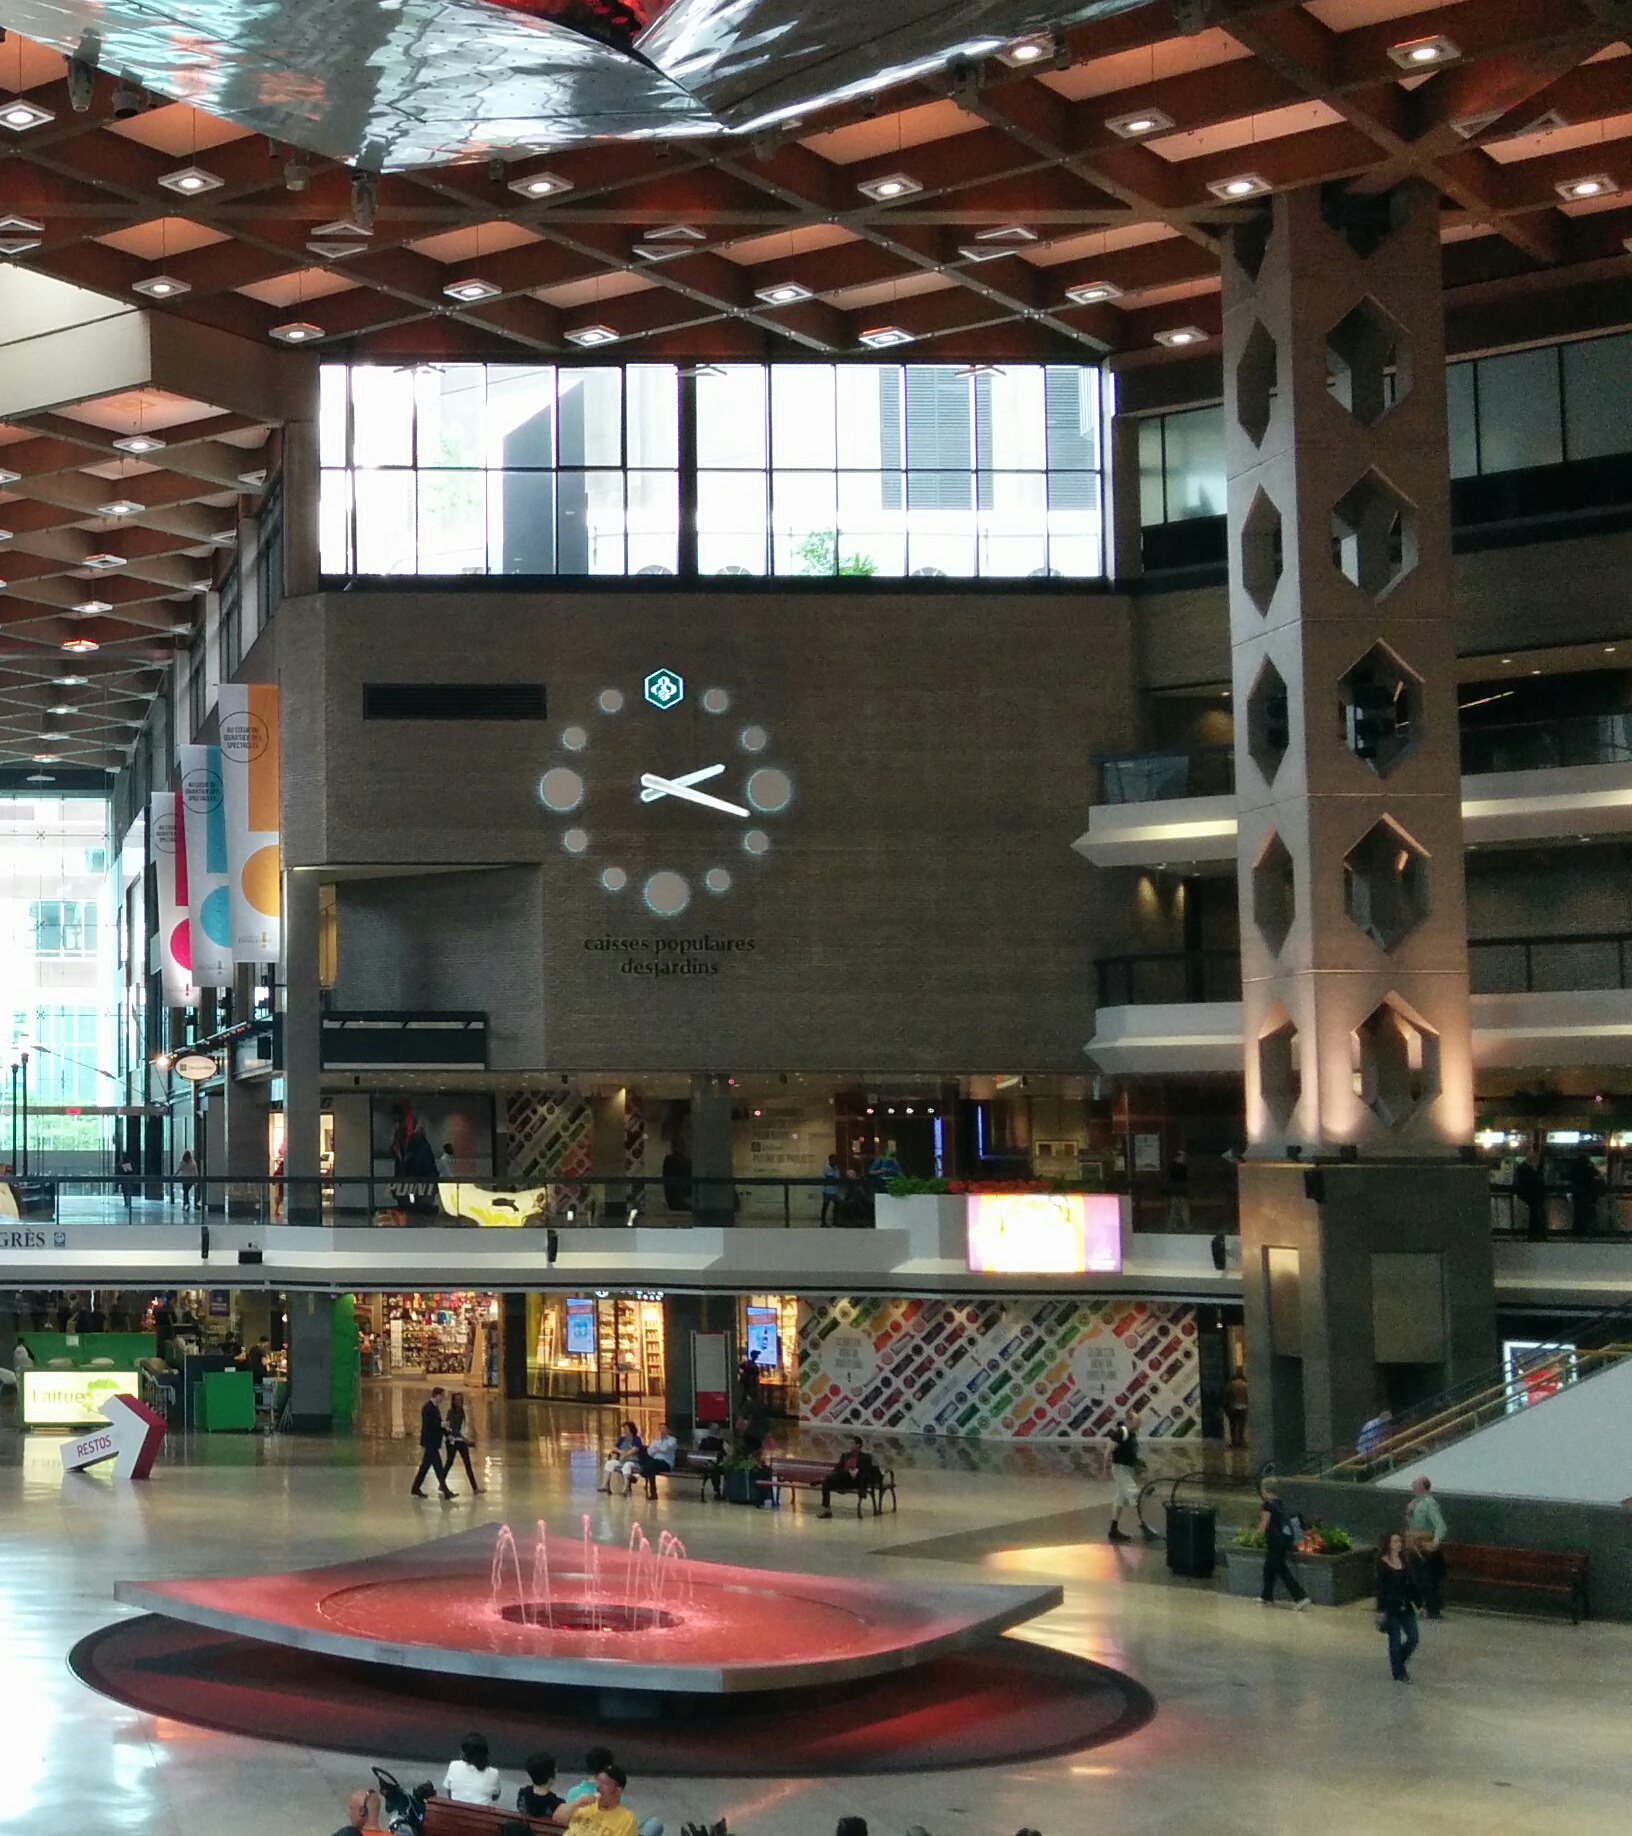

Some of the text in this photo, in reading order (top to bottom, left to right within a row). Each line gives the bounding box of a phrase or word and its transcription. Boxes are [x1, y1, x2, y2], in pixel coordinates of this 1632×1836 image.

[583, 934, 755, 955] caisses populaires
[621, 958, 719, 977] desjardins
[76, 1434, 112, 1459] RESTOS
